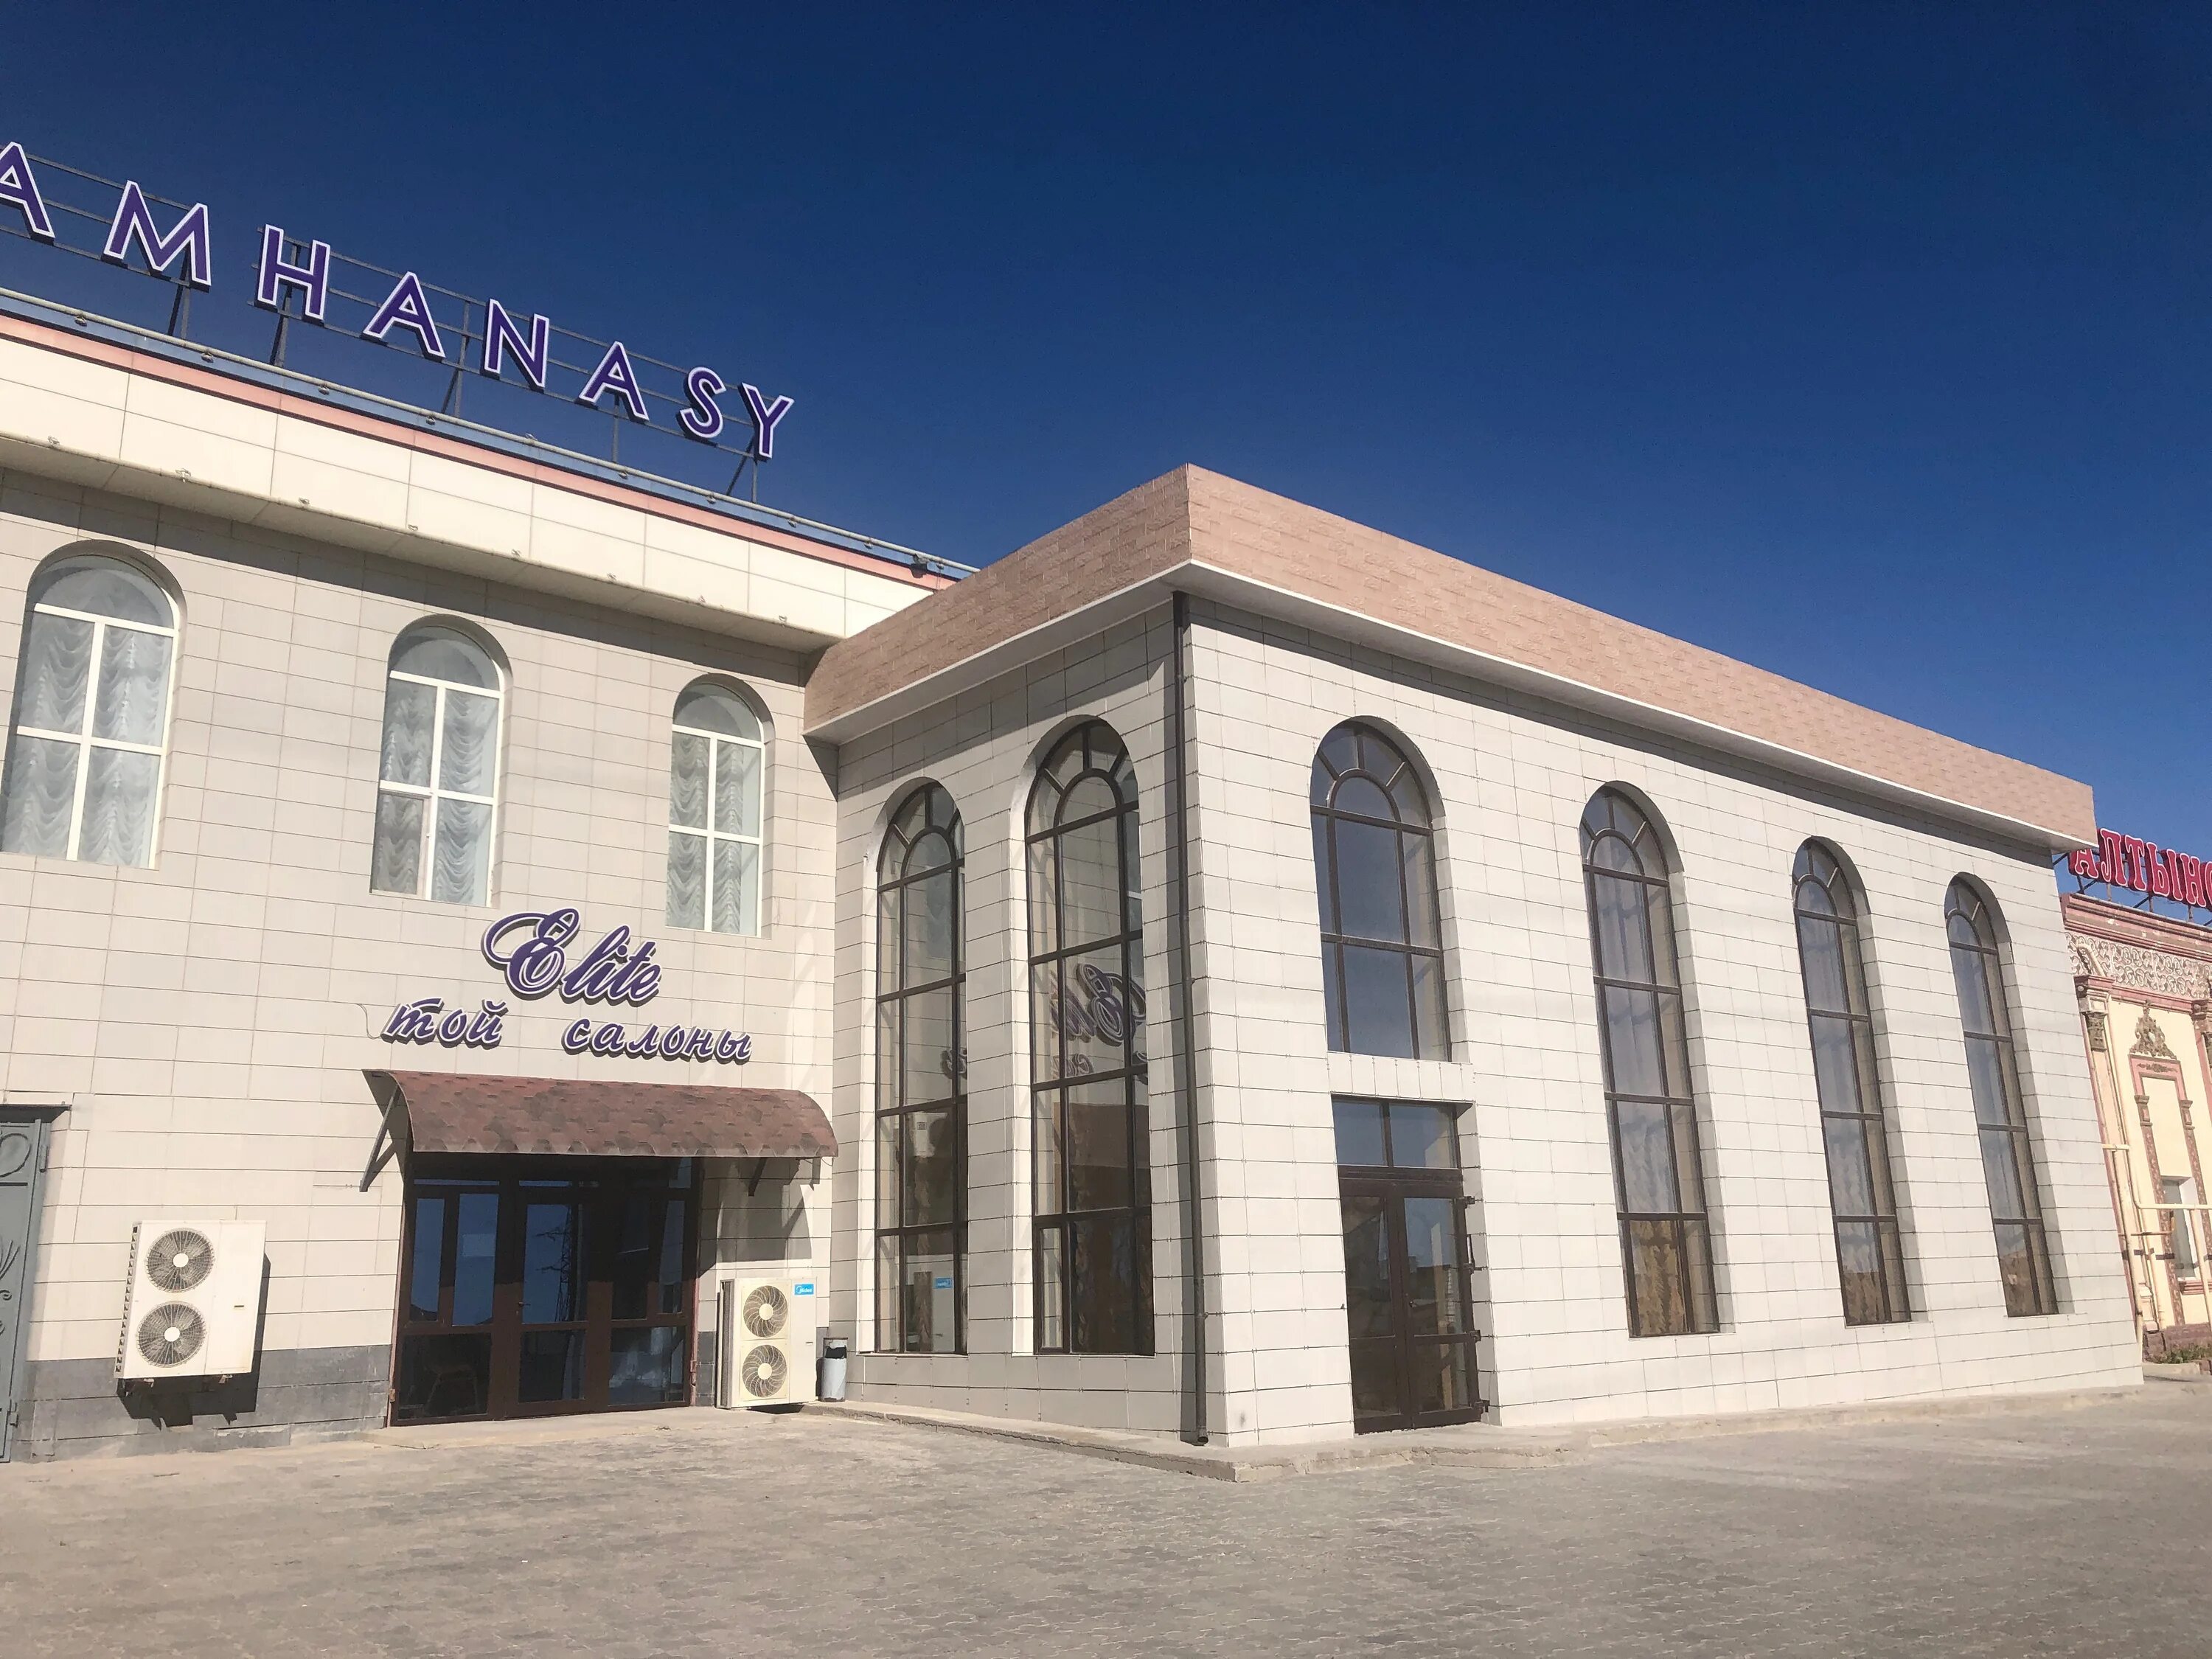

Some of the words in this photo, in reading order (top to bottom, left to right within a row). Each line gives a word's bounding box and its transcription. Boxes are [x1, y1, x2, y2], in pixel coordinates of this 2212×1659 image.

[481, 907, 662, 1003] Elite
[380, 998, 507, 1046] той
[563, 1018, 752, 1061] салоны
